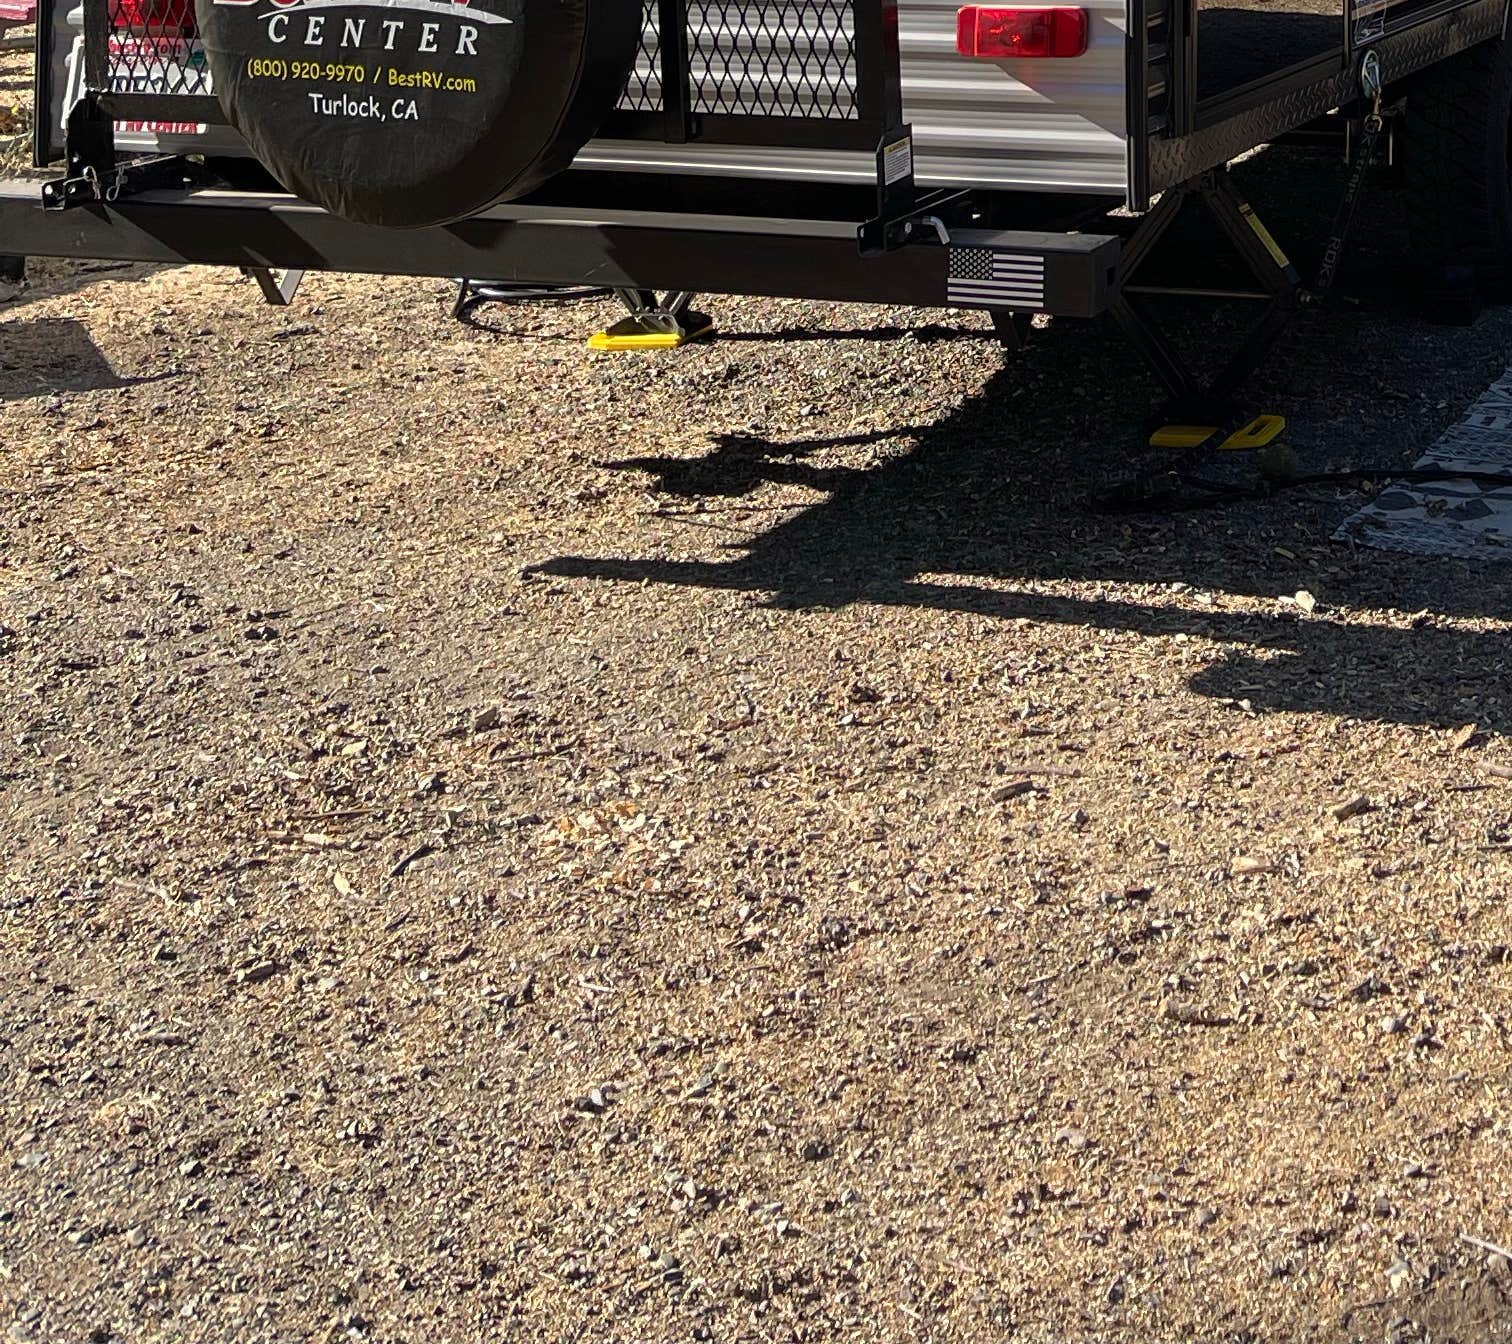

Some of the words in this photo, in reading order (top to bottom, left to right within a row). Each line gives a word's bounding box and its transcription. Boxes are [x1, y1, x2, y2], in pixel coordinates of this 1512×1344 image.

[267, 13, 479, 56] CENTER
[247, 57, 288, 81] (800)
[291, 61, 366, 84] 920-9970
[387, 68, 478, 93] BestRV.com
[307, 92, 387, 123] Turlock,
[390, 98, 420, 122] CA
